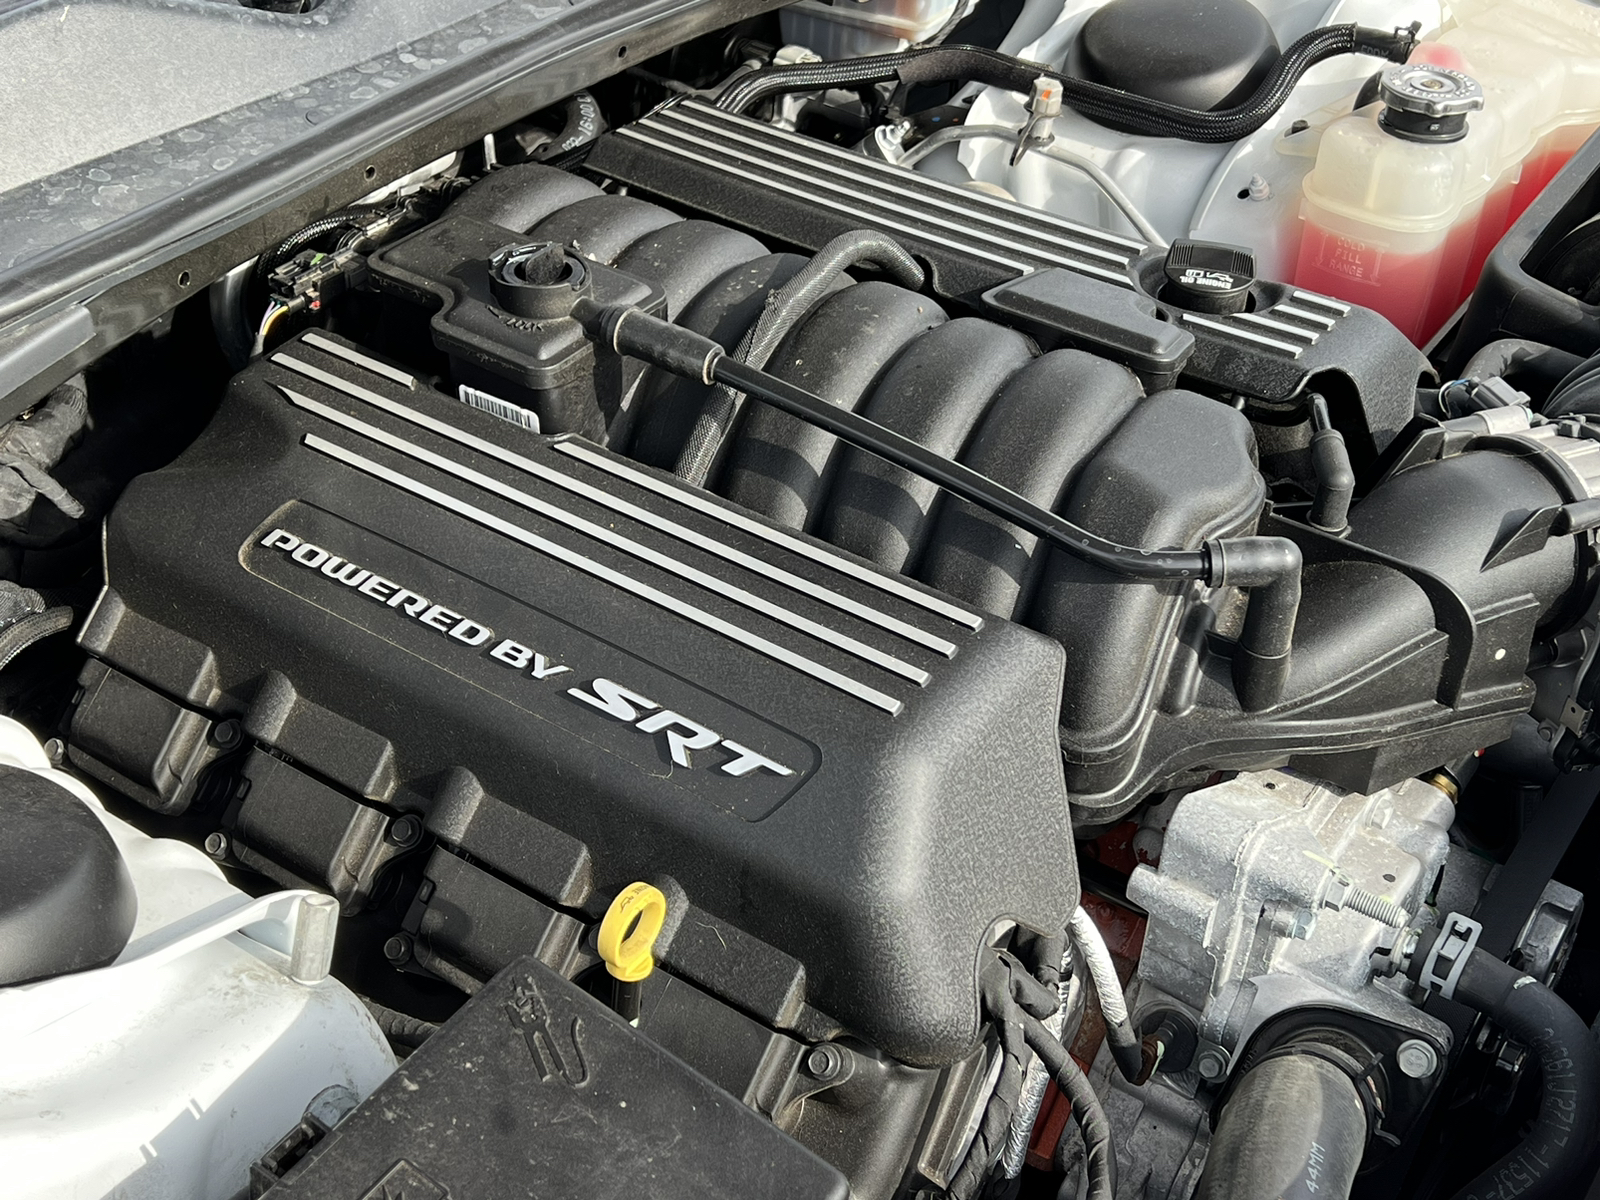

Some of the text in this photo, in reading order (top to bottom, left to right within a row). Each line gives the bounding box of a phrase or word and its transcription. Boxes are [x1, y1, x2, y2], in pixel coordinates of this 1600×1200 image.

[1337, 236, 1365, 252] COLD
[1334, 248, 1362, 265] FILL
[1328, 259, 1364, 278] RANGE
[1179, 276, 1233, 290] ENGINE OIL
[260, 528, 795, 778] POWERED BY SRT
[1304, 1141, 1326, 1194] 44MM
